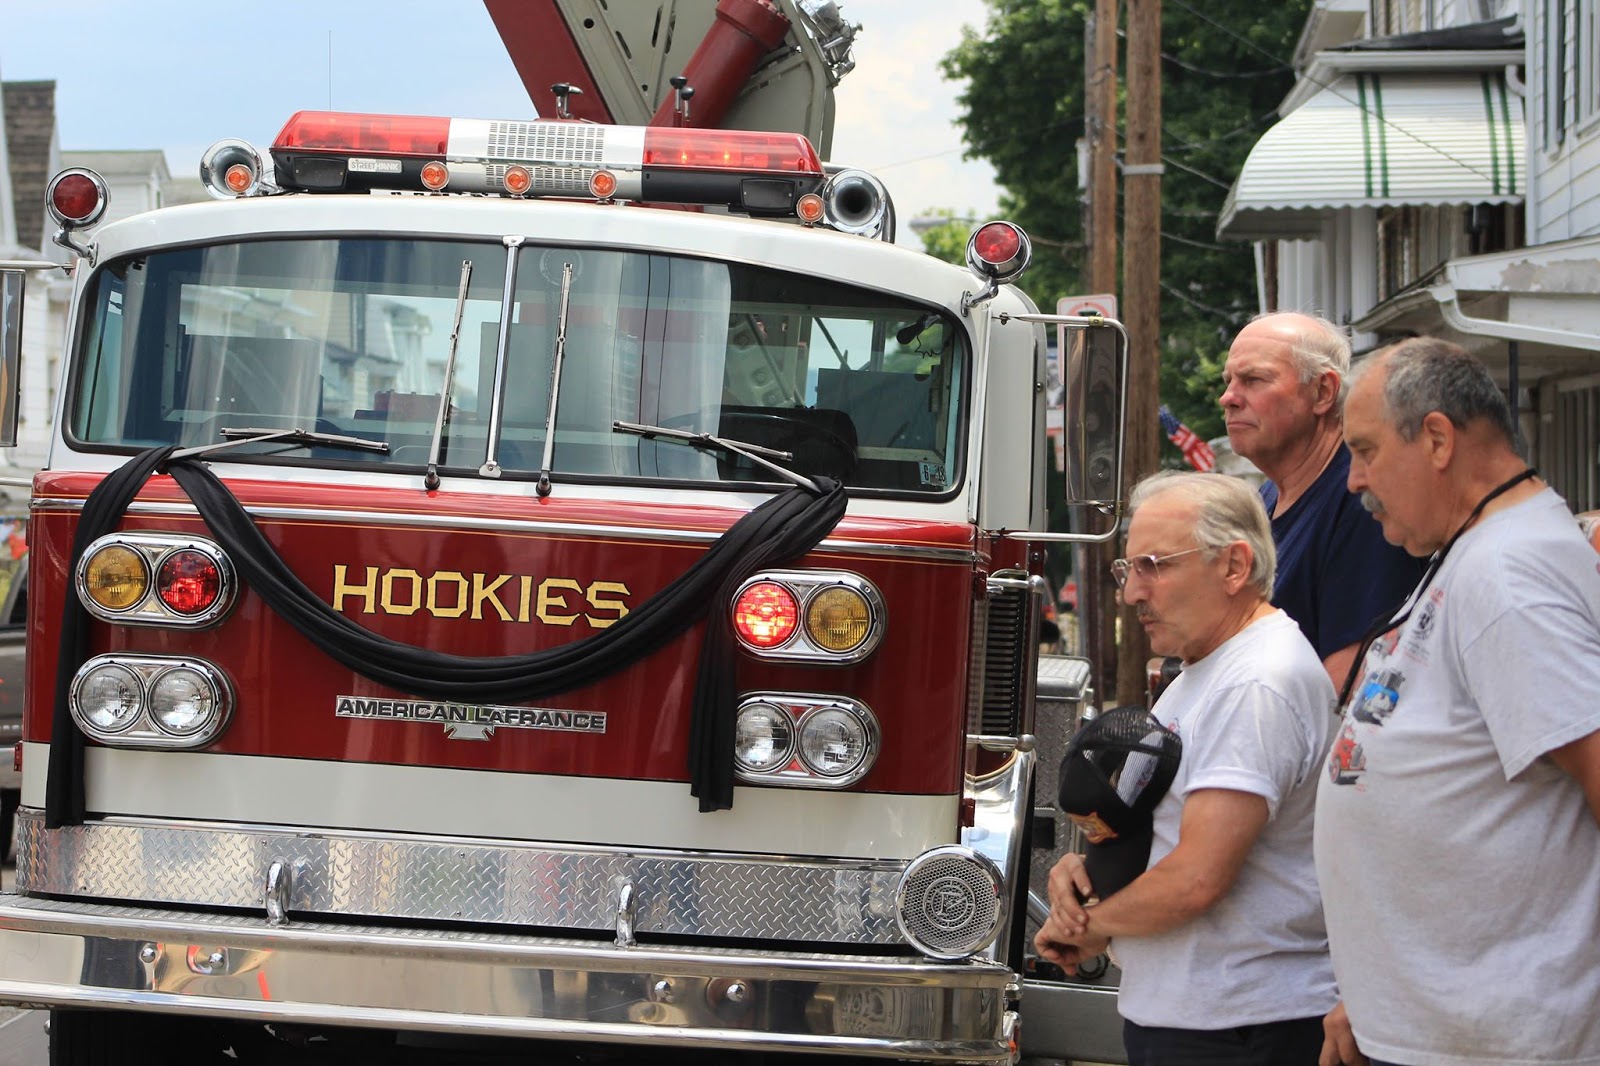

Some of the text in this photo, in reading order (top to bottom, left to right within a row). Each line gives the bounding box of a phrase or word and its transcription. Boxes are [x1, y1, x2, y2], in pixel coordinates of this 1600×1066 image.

[332, 564, 631, 629] HOOKIES
[336, 698, 605, 729] AMERICAN LAFRANCE
